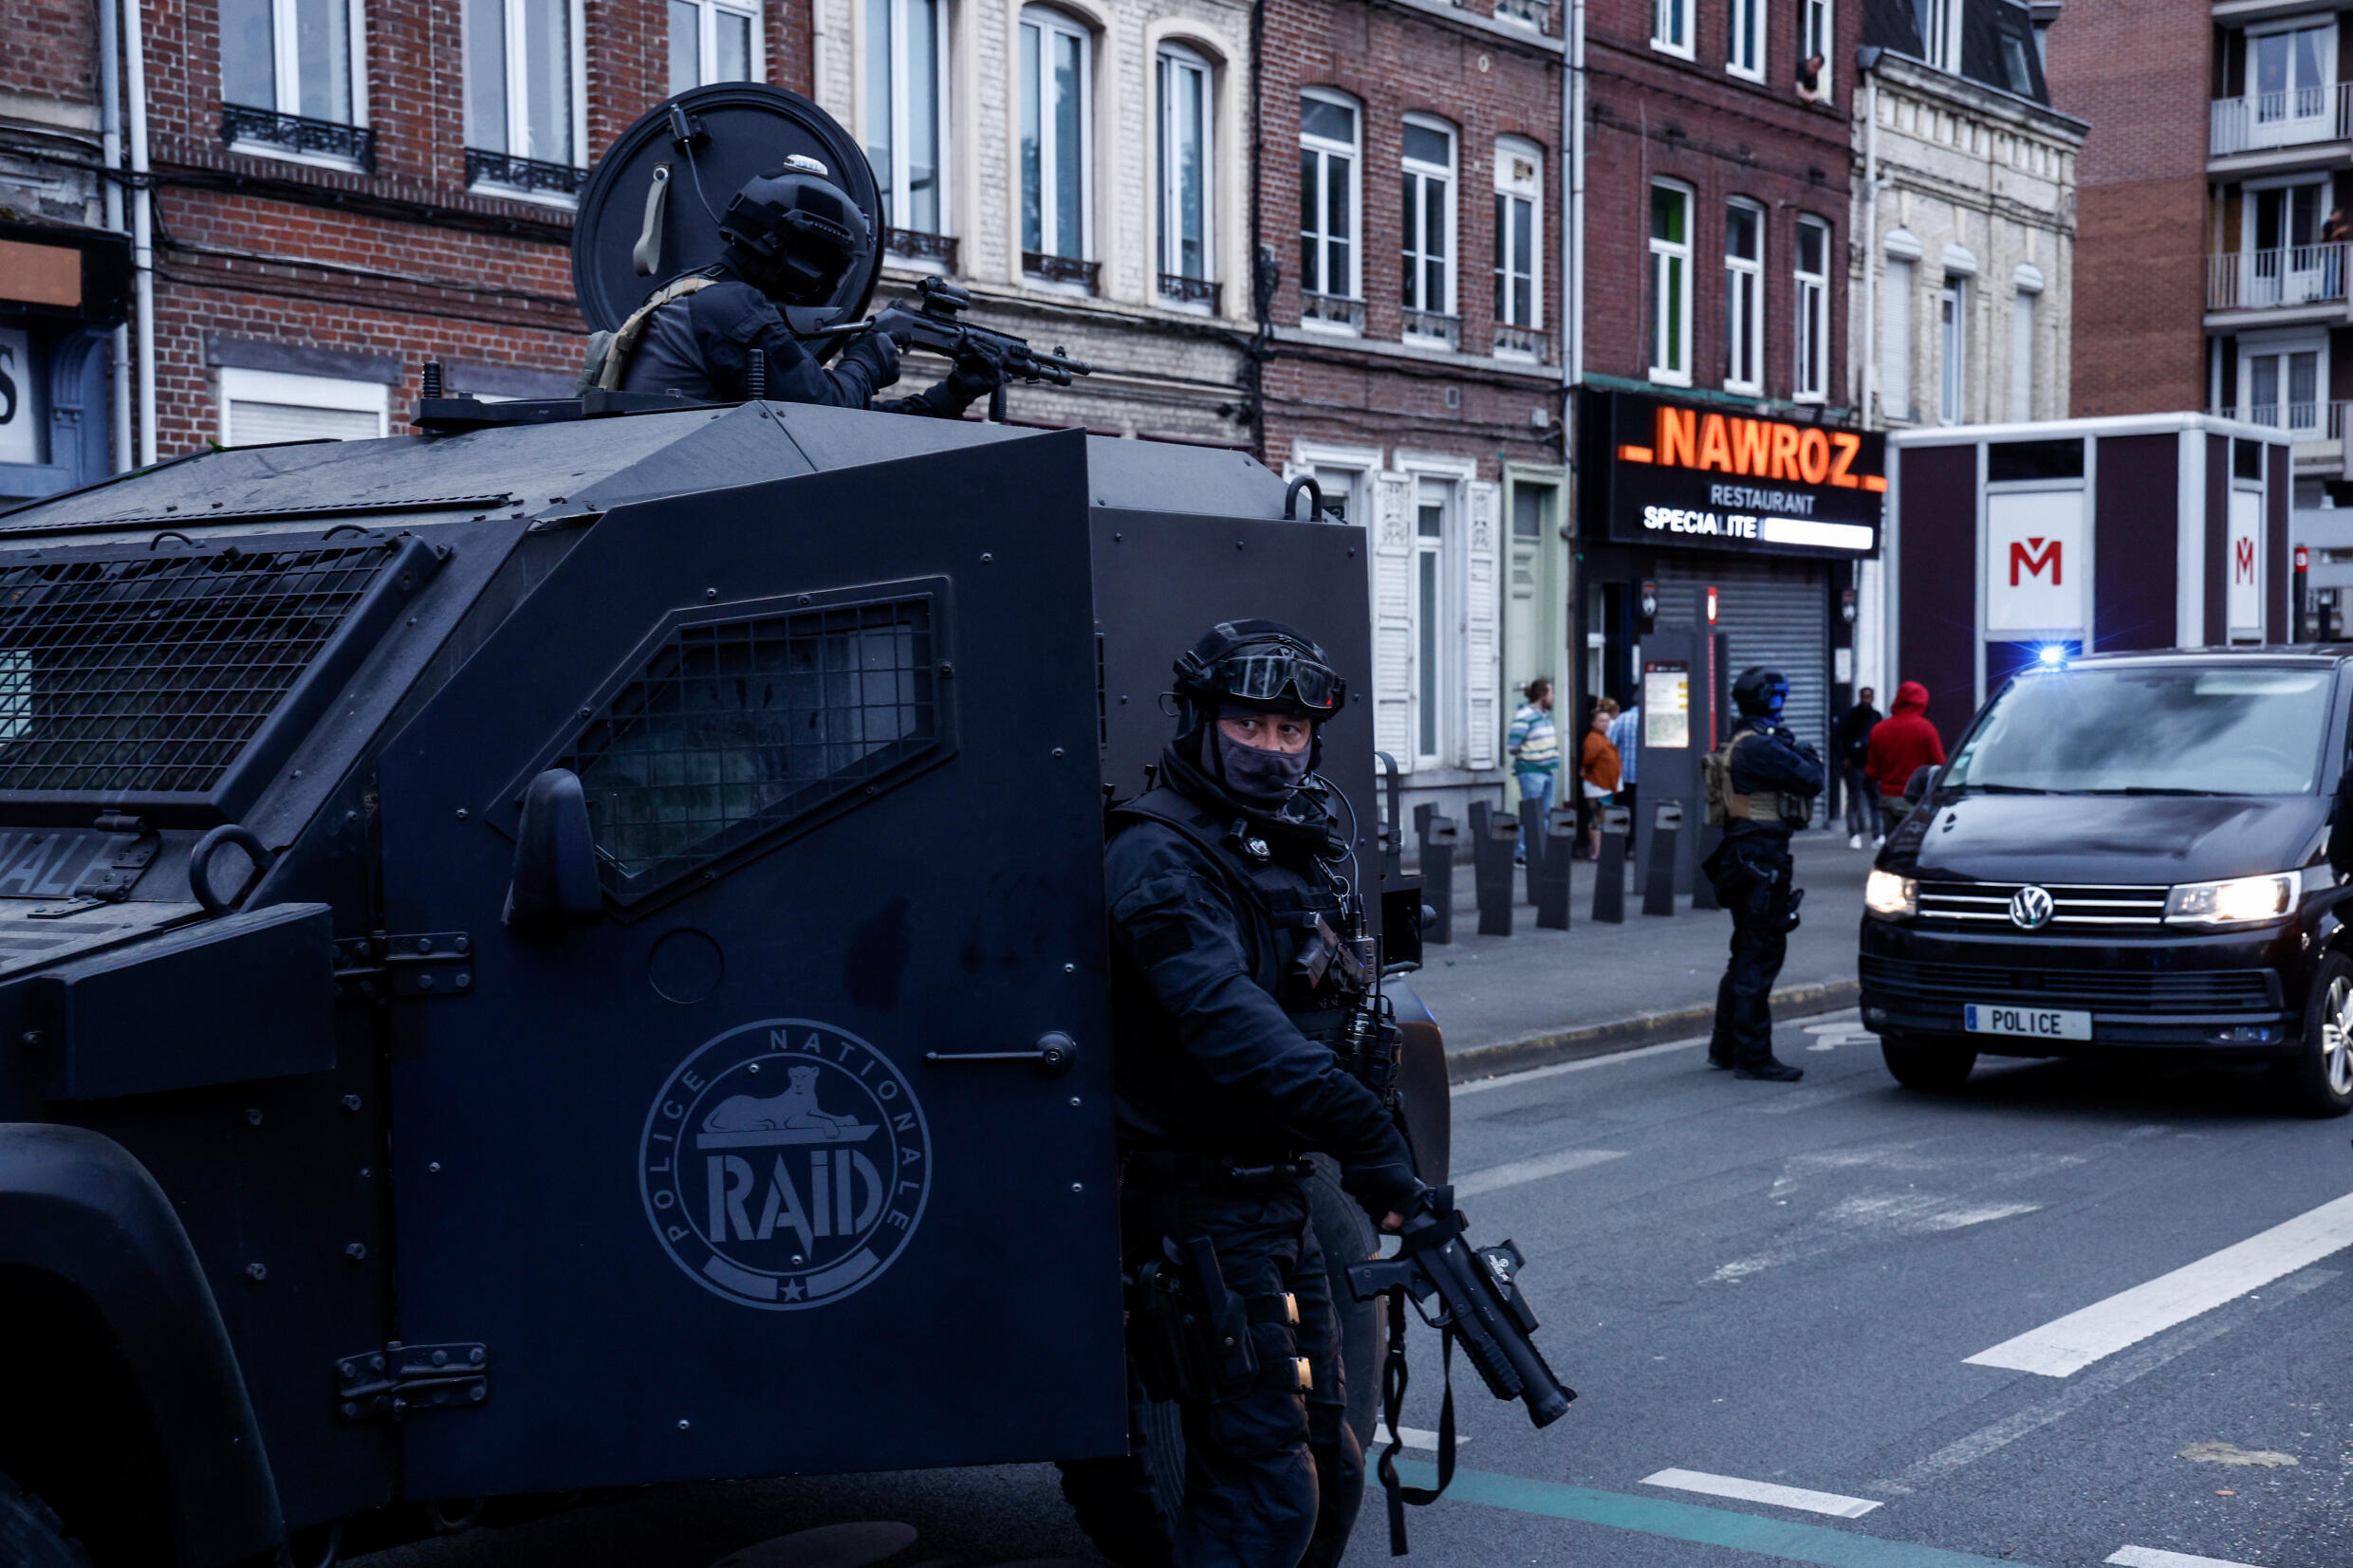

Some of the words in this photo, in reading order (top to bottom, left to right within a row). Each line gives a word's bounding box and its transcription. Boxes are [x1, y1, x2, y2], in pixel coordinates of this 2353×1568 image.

[1657, 406, 1861, 489] NAWROZ
[1711, 484, 1815, 515] RESTAURANT
[1643, 506, 1757, 539] SPECIALITE
[1992, 1010, 2062, 1035] POLICE
[650, 1069, 705, 1243] POLICE
[770, 1029, 921, 1231] NATIONALE
